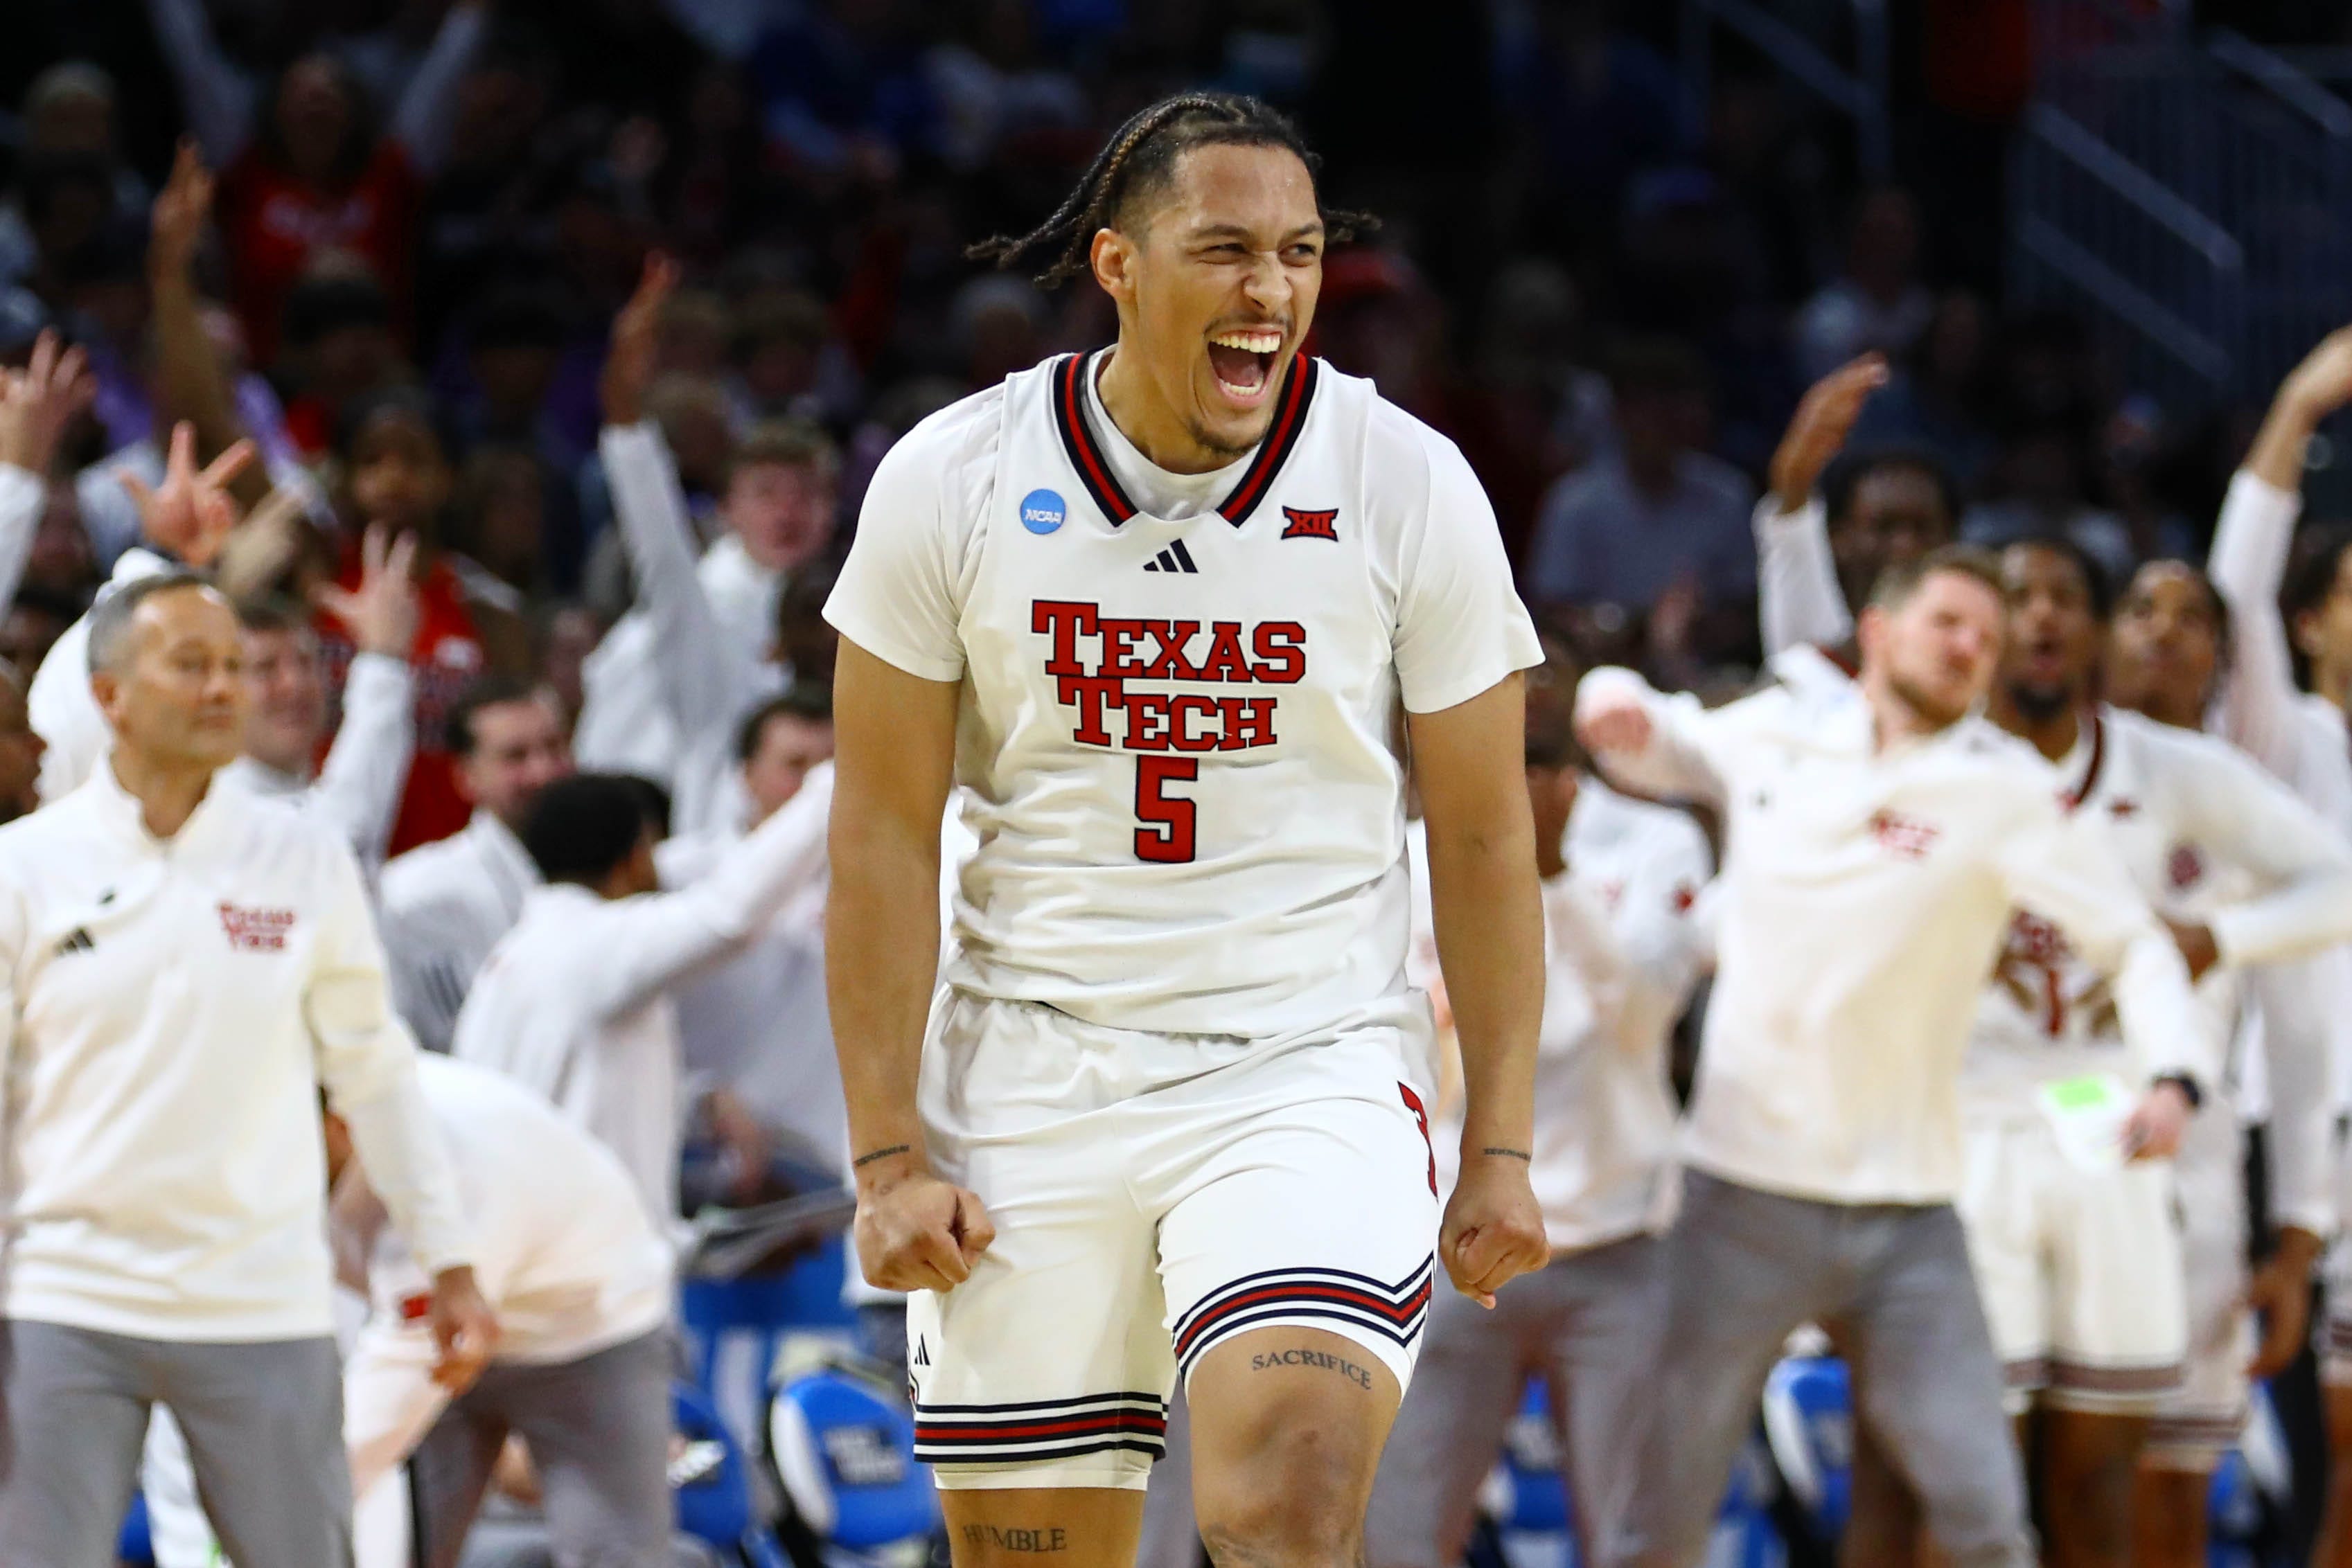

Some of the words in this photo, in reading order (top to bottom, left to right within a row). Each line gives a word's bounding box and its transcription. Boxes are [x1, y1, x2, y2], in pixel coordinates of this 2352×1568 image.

[1025, 508, 1062, 524] NCAA
[1281, 505, 1339, 542] XII
[1032, 600, 1306, 684] TEXAS
[1057, 675, 1277, 751] TECH
[1134, 754, 1199, 863] 5
[1252, 1348, 1372, 1390] SACRIFICE
[964, 1524, 1068, 1552] HUMBLE
